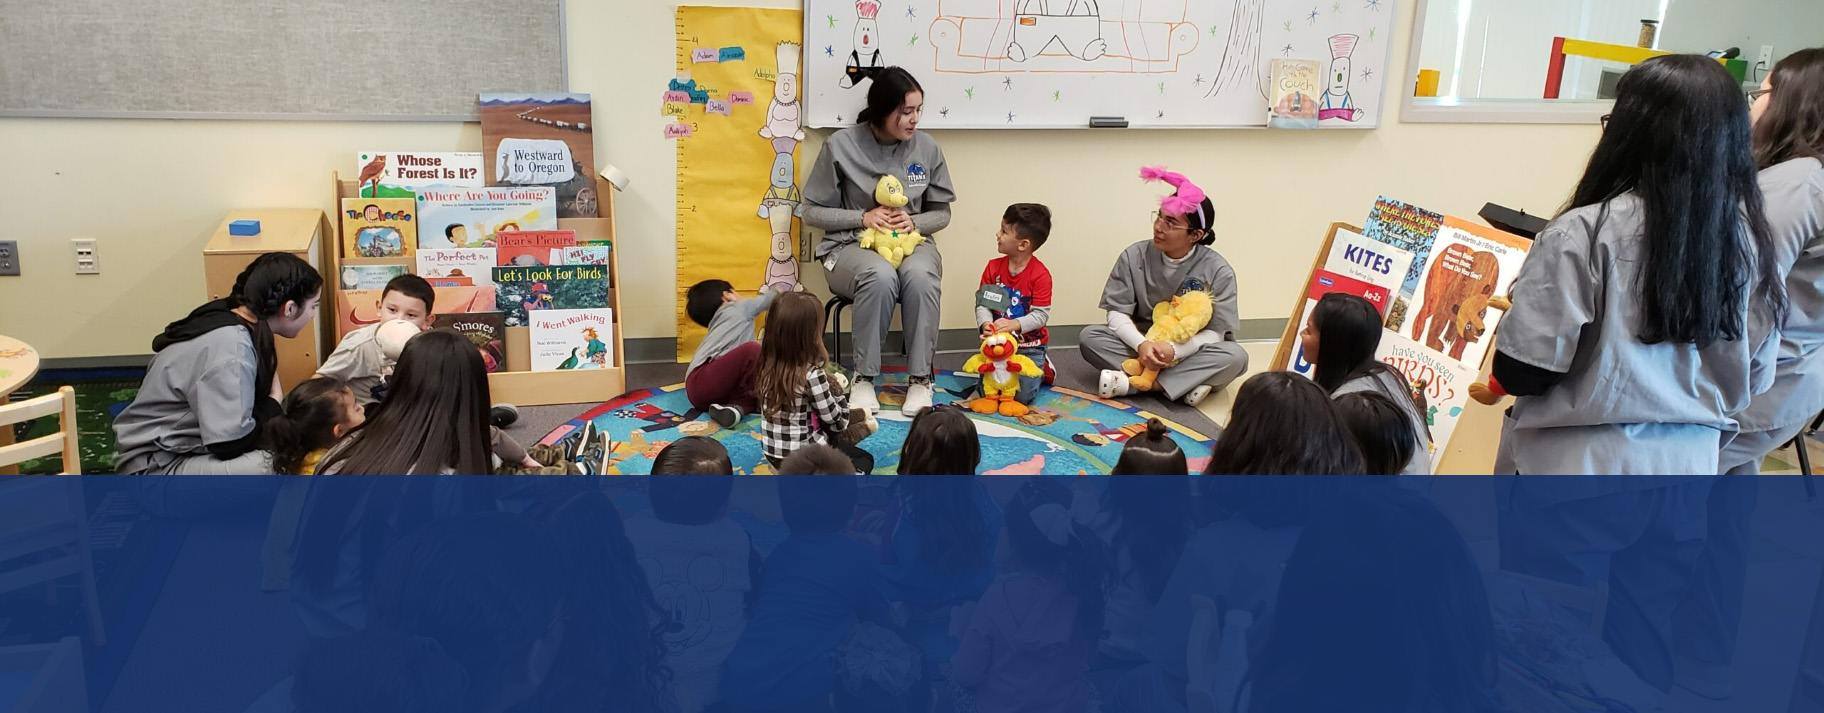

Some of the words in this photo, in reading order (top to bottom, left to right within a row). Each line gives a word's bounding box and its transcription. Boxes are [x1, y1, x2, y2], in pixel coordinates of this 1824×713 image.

[754, 68, 776, 80] Adolpho
[1280, 77, 1314, 91] Couch
[710, 101, 725, 112] Bella
[692, 122, 698, 132] 3
[397, 154, 442, 166] Whose
[514, 150, 564, 161] Westward
[397, 168, 440, 178] Forest
[443, 168, 456, 179] Is
[460, 168, 478, 179] It?
[514, 162, 524, 173] to
[528, 162, 566, 176] Oregon
[424, 191, 460, 202] Where
[464, 190, 484, 200] Are
[486, 190, 507, 200] You
[510, 189, 550, 202] Going?
[346, 210, 363, 220] The
[363, 204, 412, 223] Cheese
[1375, 199, 1400, 216] WHERE
[1401, 208, 1416, 222] THE
[1416, 213, 1444, 230] FORES
[1378, 210, 1402, 226] MEETS
[1416, 224, 1432, 237] SEA
[500, 235, 532, 246] Bear's
[536, 234, 574, 246] Picture
[1452, 232, 1462, 240] Bill
[1462, 234, 1477, 245] Martin
[1484, 242, 1496, 251] Eric
[1494, 246, 1508, 255] Carle
[436, 252, 477, 261] Perfect
[1343, 244, 1394, 276] KITES
[1444, 254, 1460, 264] Brown
[1446, 247, 1462, 258] Brown
[1462, 252, 1474, 262] Bear,
[498, 268, 522, 282] Let's
[526, 268, 552, 281] Look
[556, 268, 574, 280] For
[576, 266, 602, 280] Birds
[1442, 261, 1455, 271] What
[1454, 265, 1462, 273] Do
[1461, 268, 1471, 276] You
[1470, 270, 1482, 281] See?
[1363, 290, 1382, 302] Aa-Zz
[452, 321, 495, 334] S'mores
[536, 320, 541, 328] I
[542, 320, 566, 330] Went
[566, 313, 606, 325] Walking
[1392, 344, 1416, 358] have
[1416, 352, 1436, 367] you
[1434, 362, 1455, 382] seen
